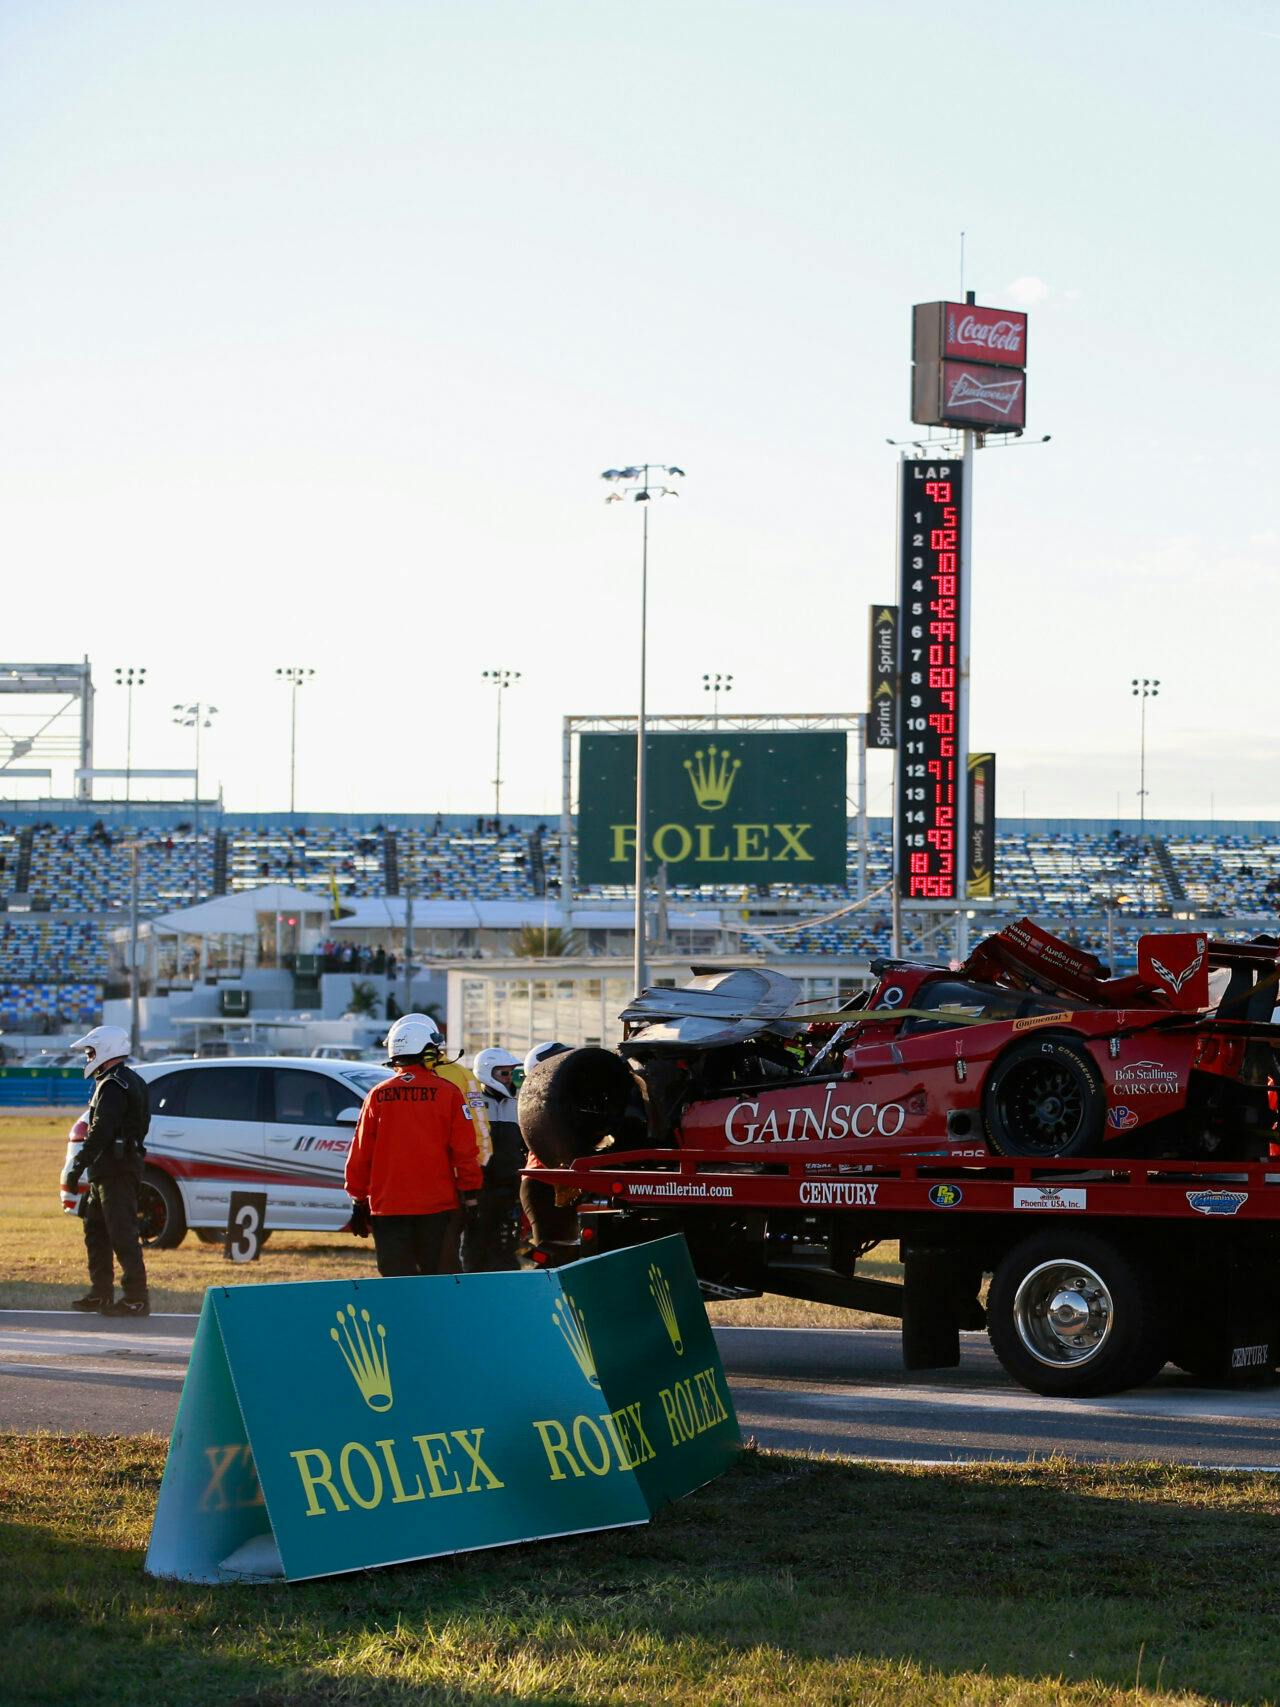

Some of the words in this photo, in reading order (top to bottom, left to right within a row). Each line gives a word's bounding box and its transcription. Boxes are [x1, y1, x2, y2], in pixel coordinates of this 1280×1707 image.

[914, 466, 950, 479] LAP
[926, 482, 951, 503] 93
[913, 511, 922, 524] 1
[943, 507, 958, 527] 5
[912, 534, 923, 546] 2
[930, 529, 958, 550] 02
[912, 557, 923, 569] 3
[938, 553, 957, 573] 10
[912, 580, 923, 592] 4
[930, 575, 956, 596] 78
[911, 602, 922, 615] 5
[930, 598, 956, 619] 42
[911, 625, 922, 638] 6
[929, 621, 955, 642] 99
[877, 628, 894, 673] Sprint
[911, 649, 922, 661] 7
[929, 645, 955, 665] 01
[910, 672, 922, 685] 8
[929, 668, 955, 688] 60
[910, 695, 921, 708] 9
[941, 691, 955, 711] 9
[877, 701, 894, 746] Sprint
[906, 718, 926, 731] 10
[928, 713, 955, 734] 90
[906, 742, 924, 754] 11
[940, 737, 953, 757] 6
[906, 765, 925, 777] 12
[928, 760, 954, 781] 91
[906, 788, 925, 800] 13
[935, 784, 953, 804] 11
[905, 811, 925, 823] 14
[609, 822, 815, 864] ROLEX
[905, 834, 925, 847] 15
[927, 829, 953, 850] 93
[972, 829, 985, 863] Sprint
[939, 853, 953, 874] 3
[1044, 945, 1070, 964] Fogarty
[1015, 1014, 1062, 1030] Continental
[1115, 1069, 1134, 1080] Bob
[1136, 1064, 1178, 1082] Stallings
[376, 1086, 438, 1103] CENTURY
[1113, 1082, 1179, 1096] CARS.COM
[724, 1081, 905, 1146] GAINSCO
[314, 1139, 351, 1152] IMS
[628, 1182, 733, 1197] www.millerind.com
[799, 1181, 878, 1205] CENTURY
[1020, 1199, 1047, 1208] Phoenix
[1051, 1200, 1067, 1209] USA,
[1068, 1200, 1081, 1209] Inc.
[231, 1205, 259, 1263] 3
[1231, 1344, 1269, 1368] CENTURY
[658, 1367, 729, 1446] ROLEX
[290, 1428, 504, 1517] ROLEX
